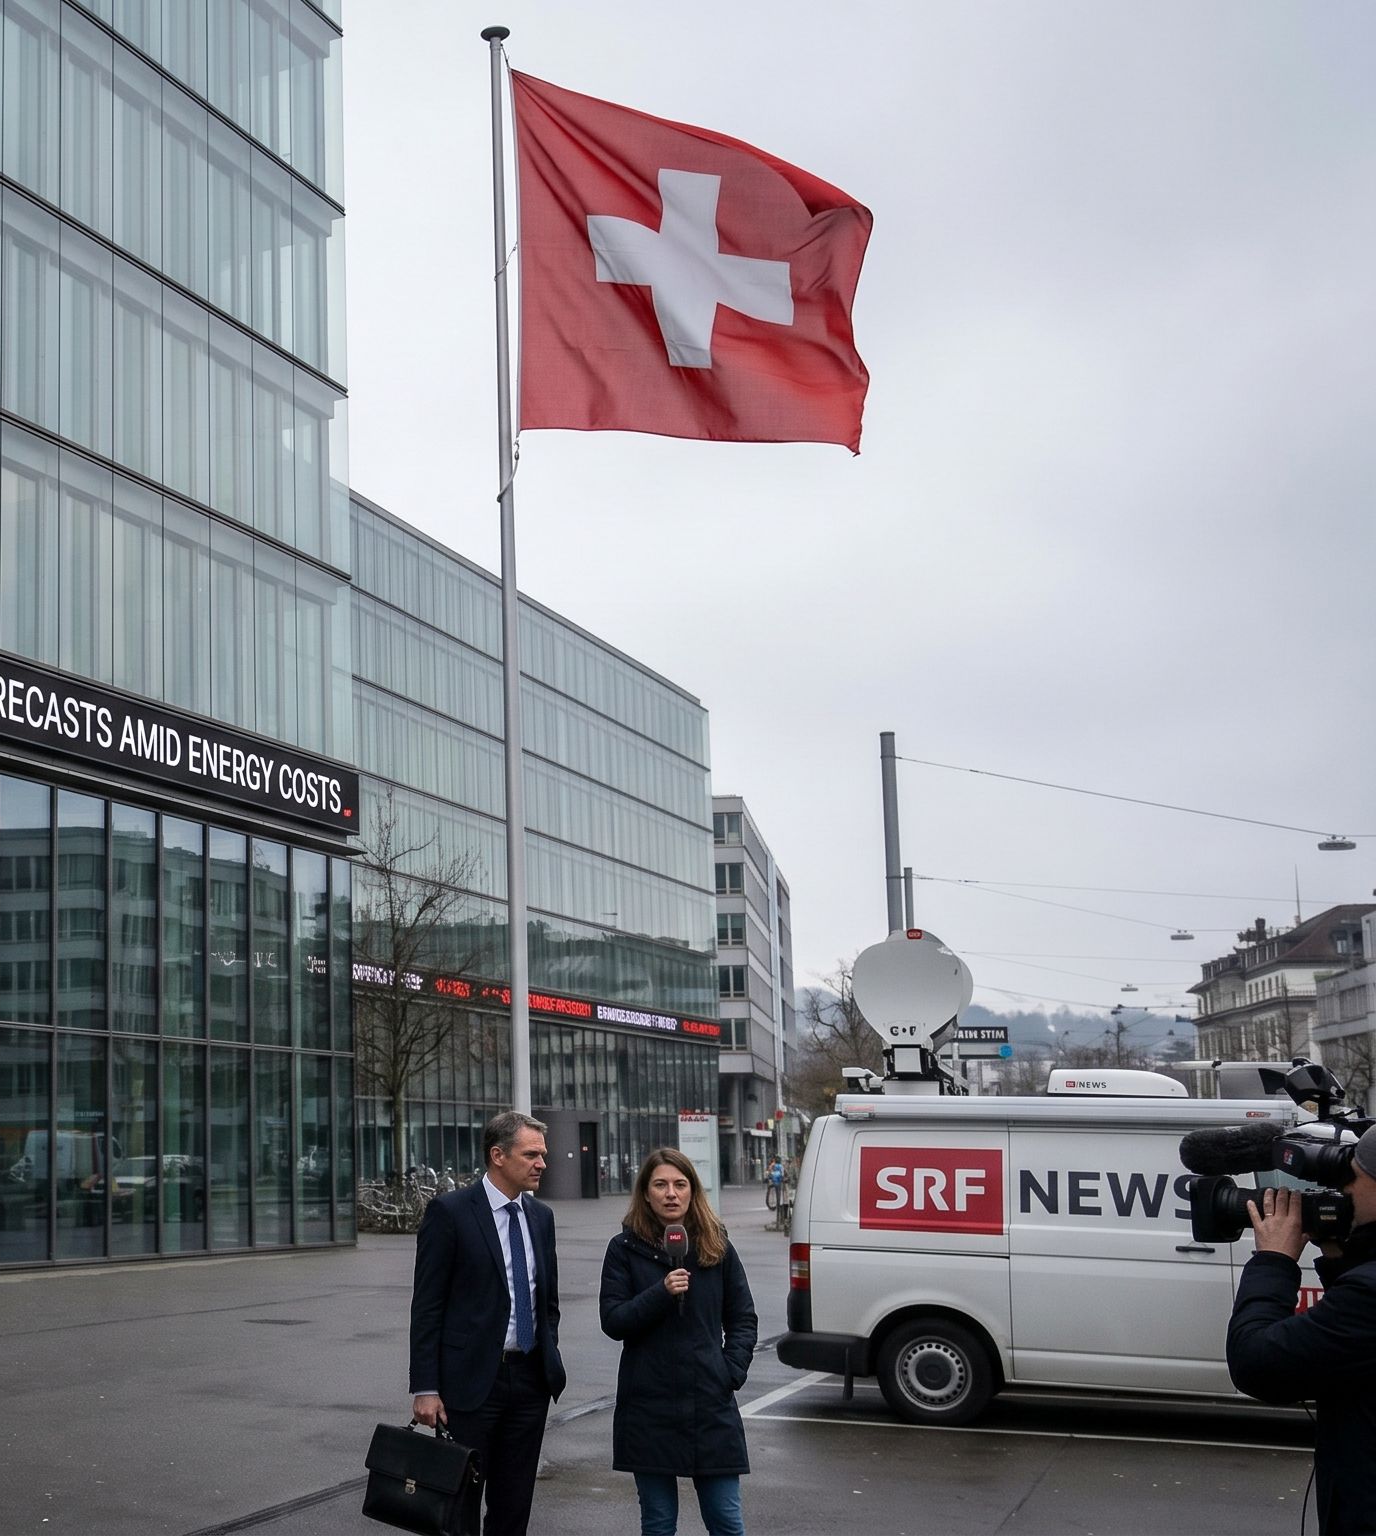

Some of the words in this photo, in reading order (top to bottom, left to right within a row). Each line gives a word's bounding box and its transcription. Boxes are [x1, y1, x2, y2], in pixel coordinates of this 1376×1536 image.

[119, 715, 182, 767] AMID
[188, 734, 275, 794] ENERGY
[279, 763, 342, 814] COSTS
[875, 1166, 987, 1212] SRF
